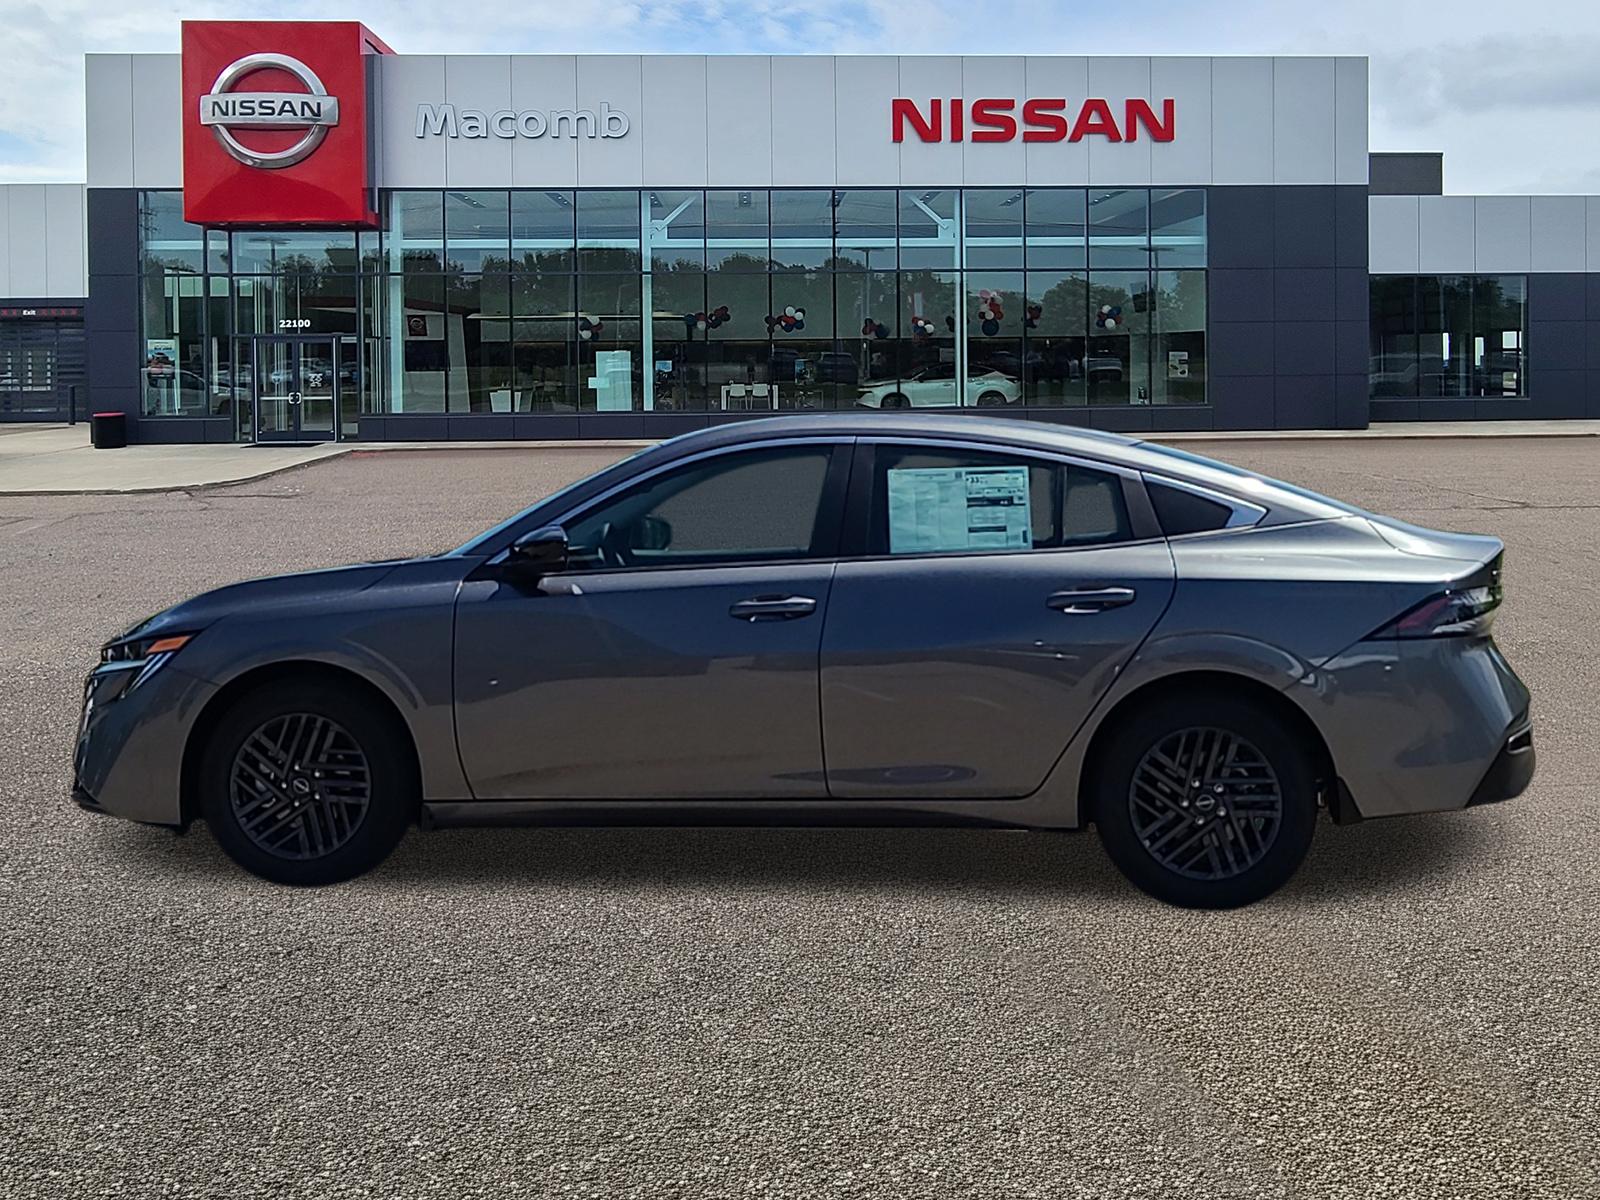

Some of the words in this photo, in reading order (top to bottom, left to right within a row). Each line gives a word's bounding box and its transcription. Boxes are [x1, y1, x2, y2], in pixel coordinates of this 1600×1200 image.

[212, 100, 321, 117] NISSAN
[415, 102, 629, 138] Macomb
[892, 98, 1174, 142] NISSAN
[279, 319, 311, 328] 22100
